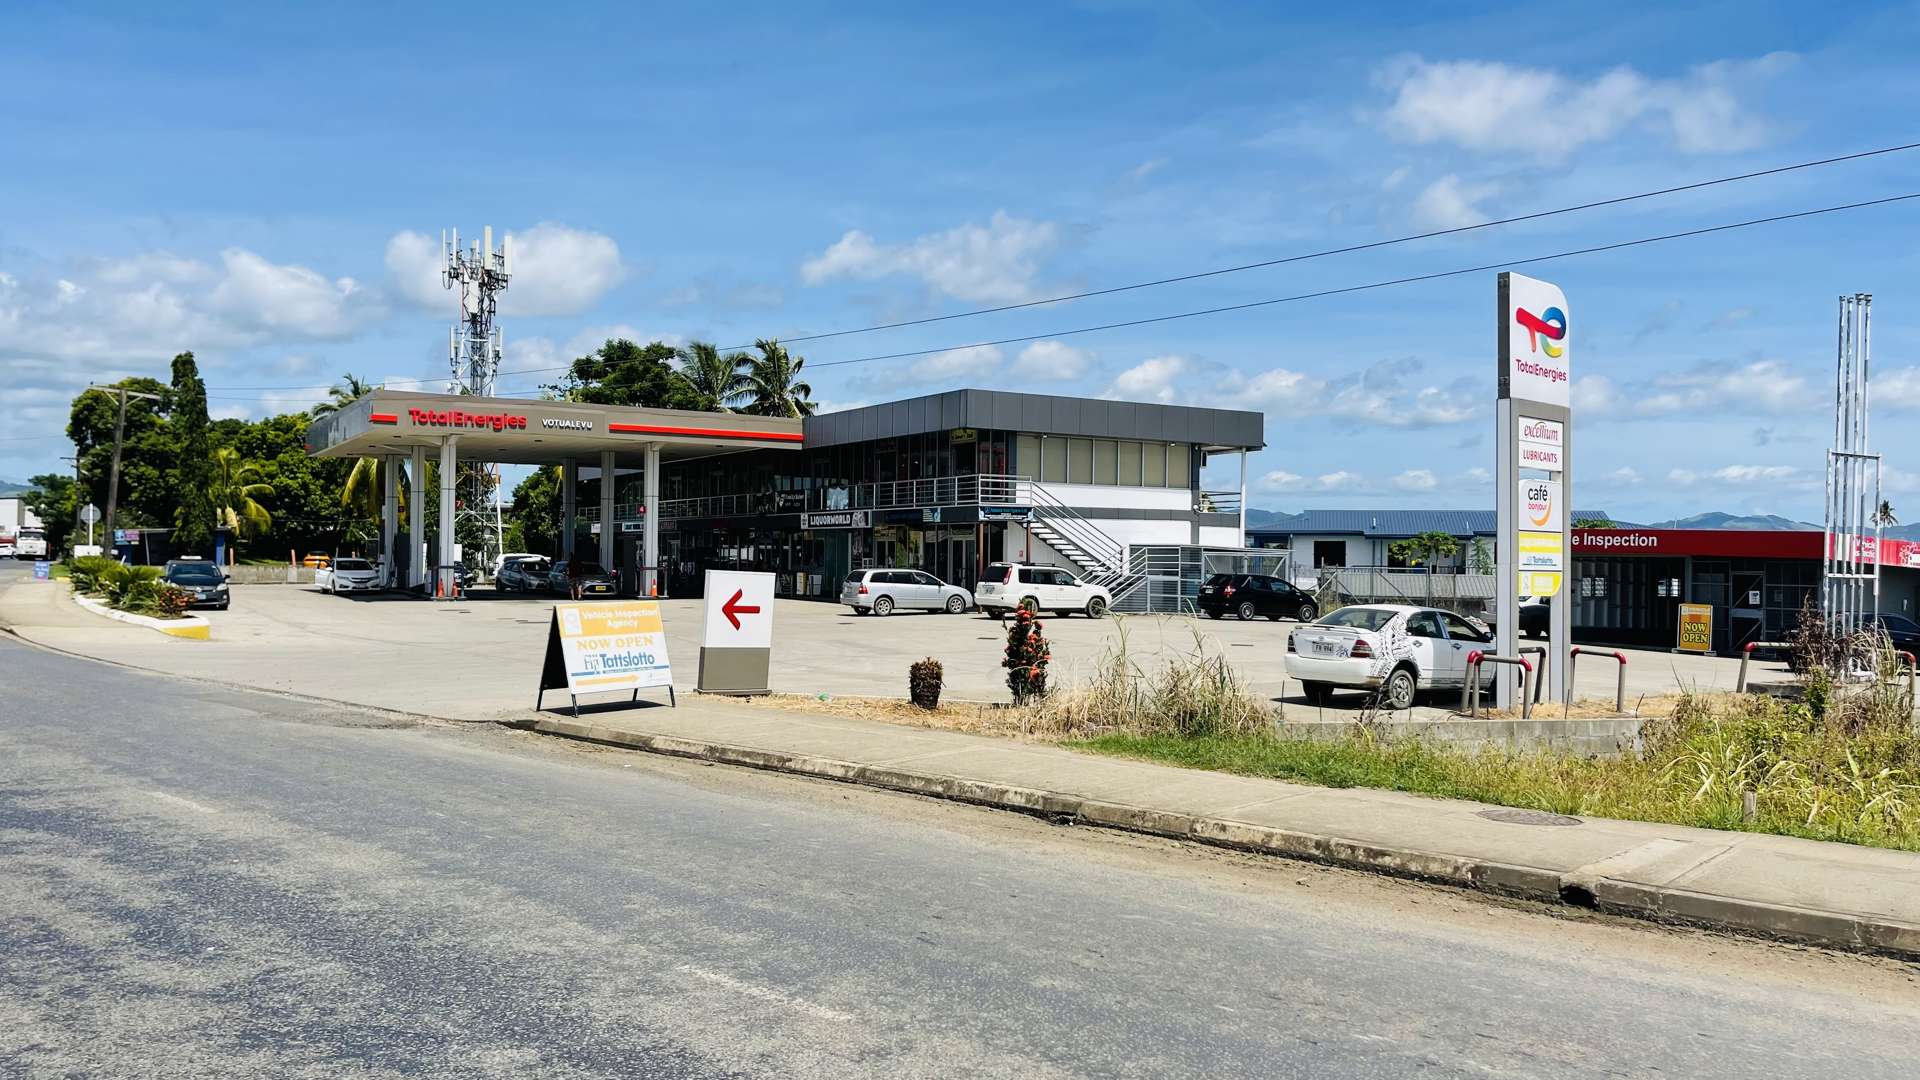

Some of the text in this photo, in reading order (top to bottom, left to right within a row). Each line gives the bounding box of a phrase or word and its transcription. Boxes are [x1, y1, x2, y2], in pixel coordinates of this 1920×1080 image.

[1515, 359, 1567, 382] TotalEnergies
[408, 408, 527, 432] TotalEnergies
[542, 418, 593, 431] VOTUALEVU
[1524, 423, 1558, 441] excellium
[1523, 448, 1558, 464] LUBRICANTS
[1527, 484, 1548, 501] café
[810, 514, 851, 526] LIQUORWORLD
[1583, 532, 1658, 549] Inspection
[1684, 622, 1707, 633] NOW
[576, 635, 654, 650] NOW OPEN
[1682, 632, 1709, 643] OPEN
[600, 651, 655, 668] Tattslotto
